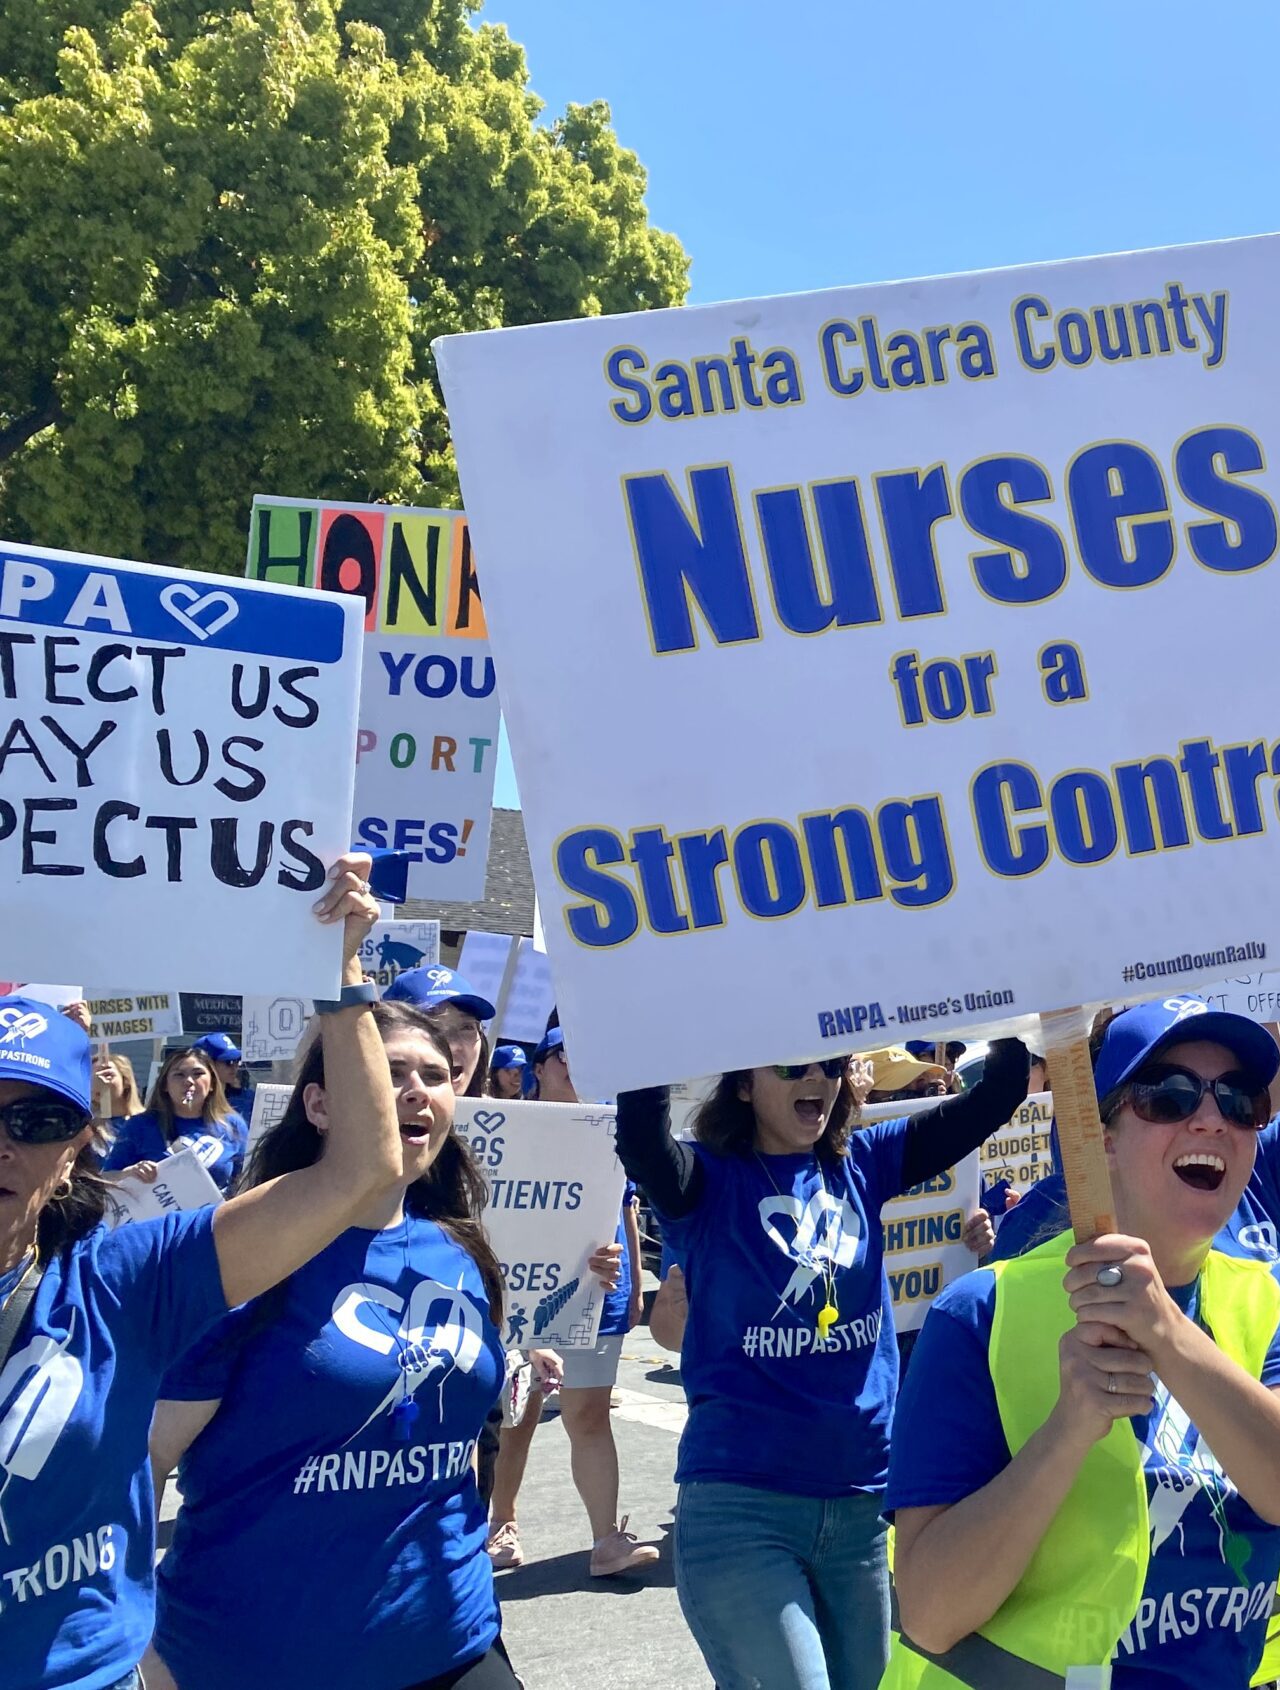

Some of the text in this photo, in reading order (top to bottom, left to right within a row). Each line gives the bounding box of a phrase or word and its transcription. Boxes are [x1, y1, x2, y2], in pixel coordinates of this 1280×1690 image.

[604, 282, 1230, 426] Santa Clara County
[620, 423, 1279, 656] Nurses
[0, 560, 132, 633] PA
[231, 664, 319, 728] US
[379, 651, 496, 698] YOU
[890, 638, 1090, 728] for a
[0, 716, 266, 802] AY US
[356, 729, 491, 773] PORT
[553, 791, 957, 952] Strong
[1122, 941, 1267, 983] #CountDownRally
[88, 995, 168, 1015] URSES WITH
[102, 1018, 153, 1037] WAGES!
[818, 1002, 887, 1038] RNPA
[897, 998, 963, 1025] Nurse's
[964, 988, 1015, 1013] Union
[0, 1049, 51, 1069] PASTRONG
[988, 1134, 1050, 1158] BUDGET
[491, 1180, 583, 1210] TIENTS
[882, 1213, 961, 1252] HTING
[888, 1267, 939, 1302] YOU
